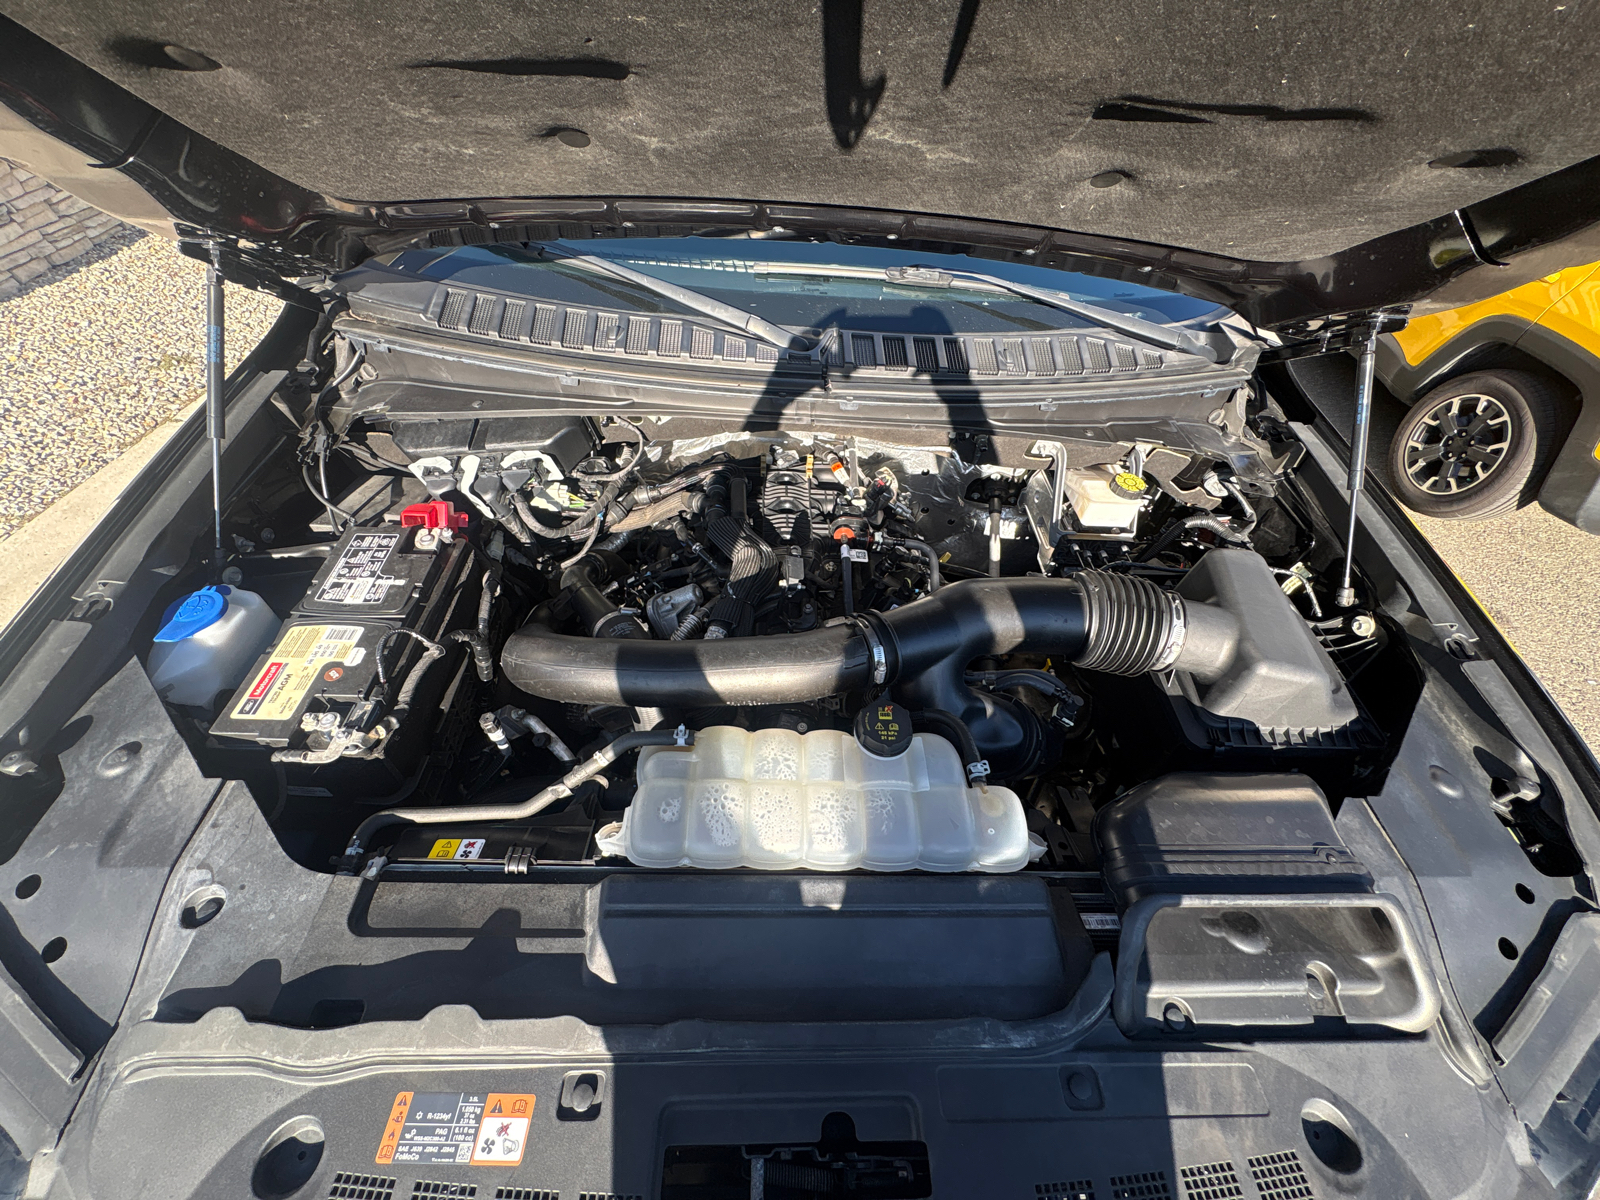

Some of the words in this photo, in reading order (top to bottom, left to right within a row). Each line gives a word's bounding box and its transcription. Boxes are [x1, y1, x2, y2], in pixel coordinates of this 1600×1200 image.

[253, 664, 279, 696] Motorcraft
[277, 673, 293, 691] AGM
[426, 1112, 452, 1121] R-1234yf
[474, 1106, 481, 1114] kg
